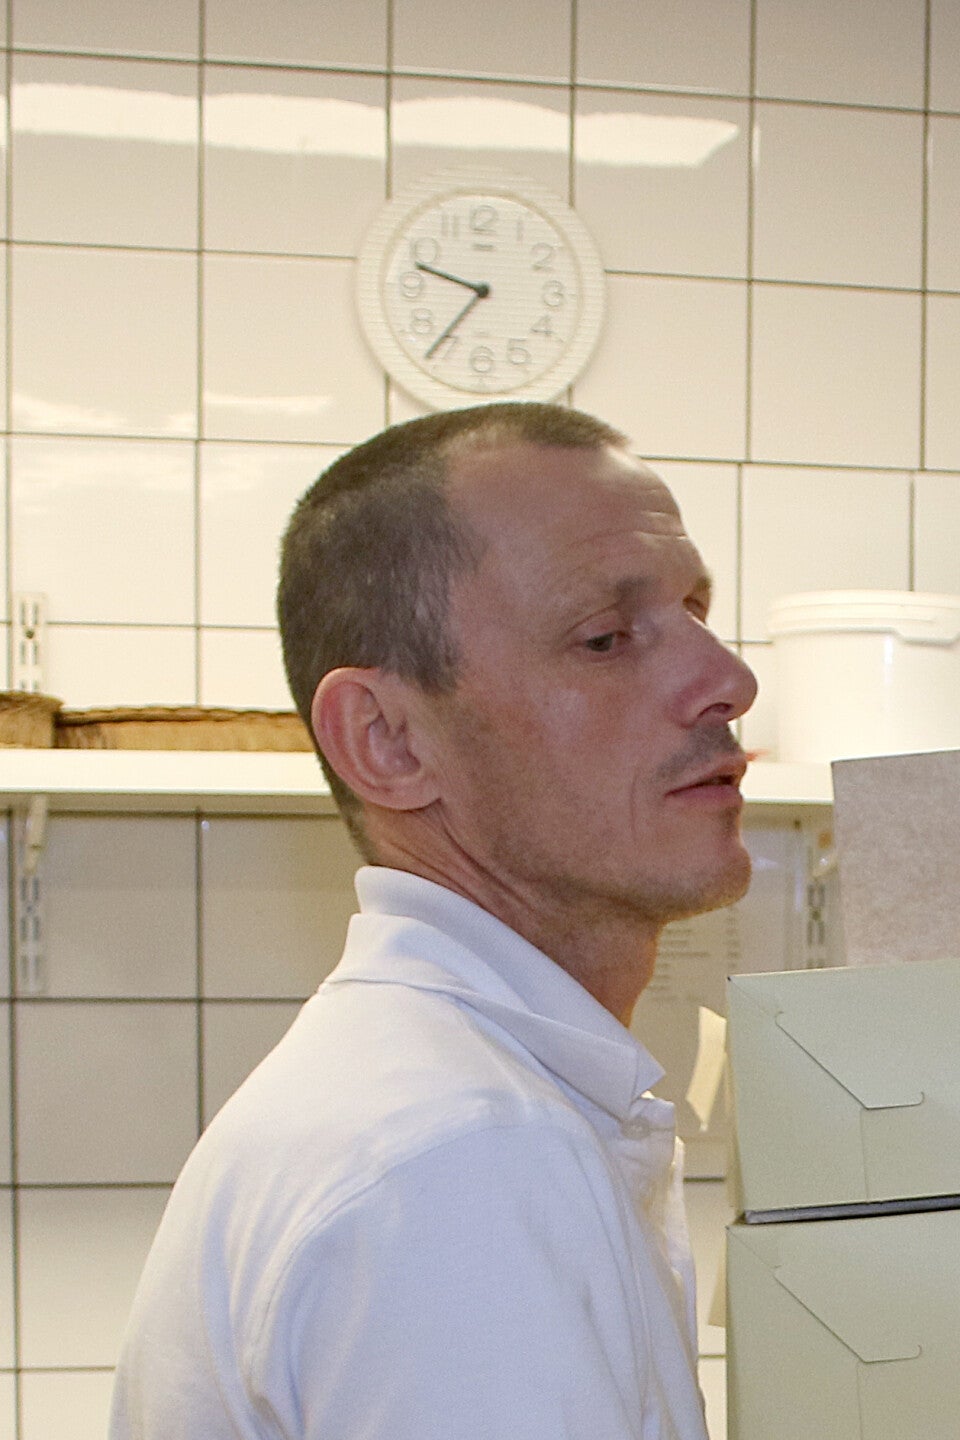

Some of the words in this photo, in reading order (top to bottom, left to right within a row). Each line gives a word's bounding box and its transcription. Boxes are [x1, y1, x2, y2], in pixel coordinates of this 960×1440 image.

[530, 243, 554, 272] 2
[400, 271, 424, 301] 9
[542, 280, 565, 307] 3
[411, 308, 433, 335] 8
[530, 315, 553, 337] 4
[469, 346, 495, 374] 6
[506, 338, 532, 366] 5
